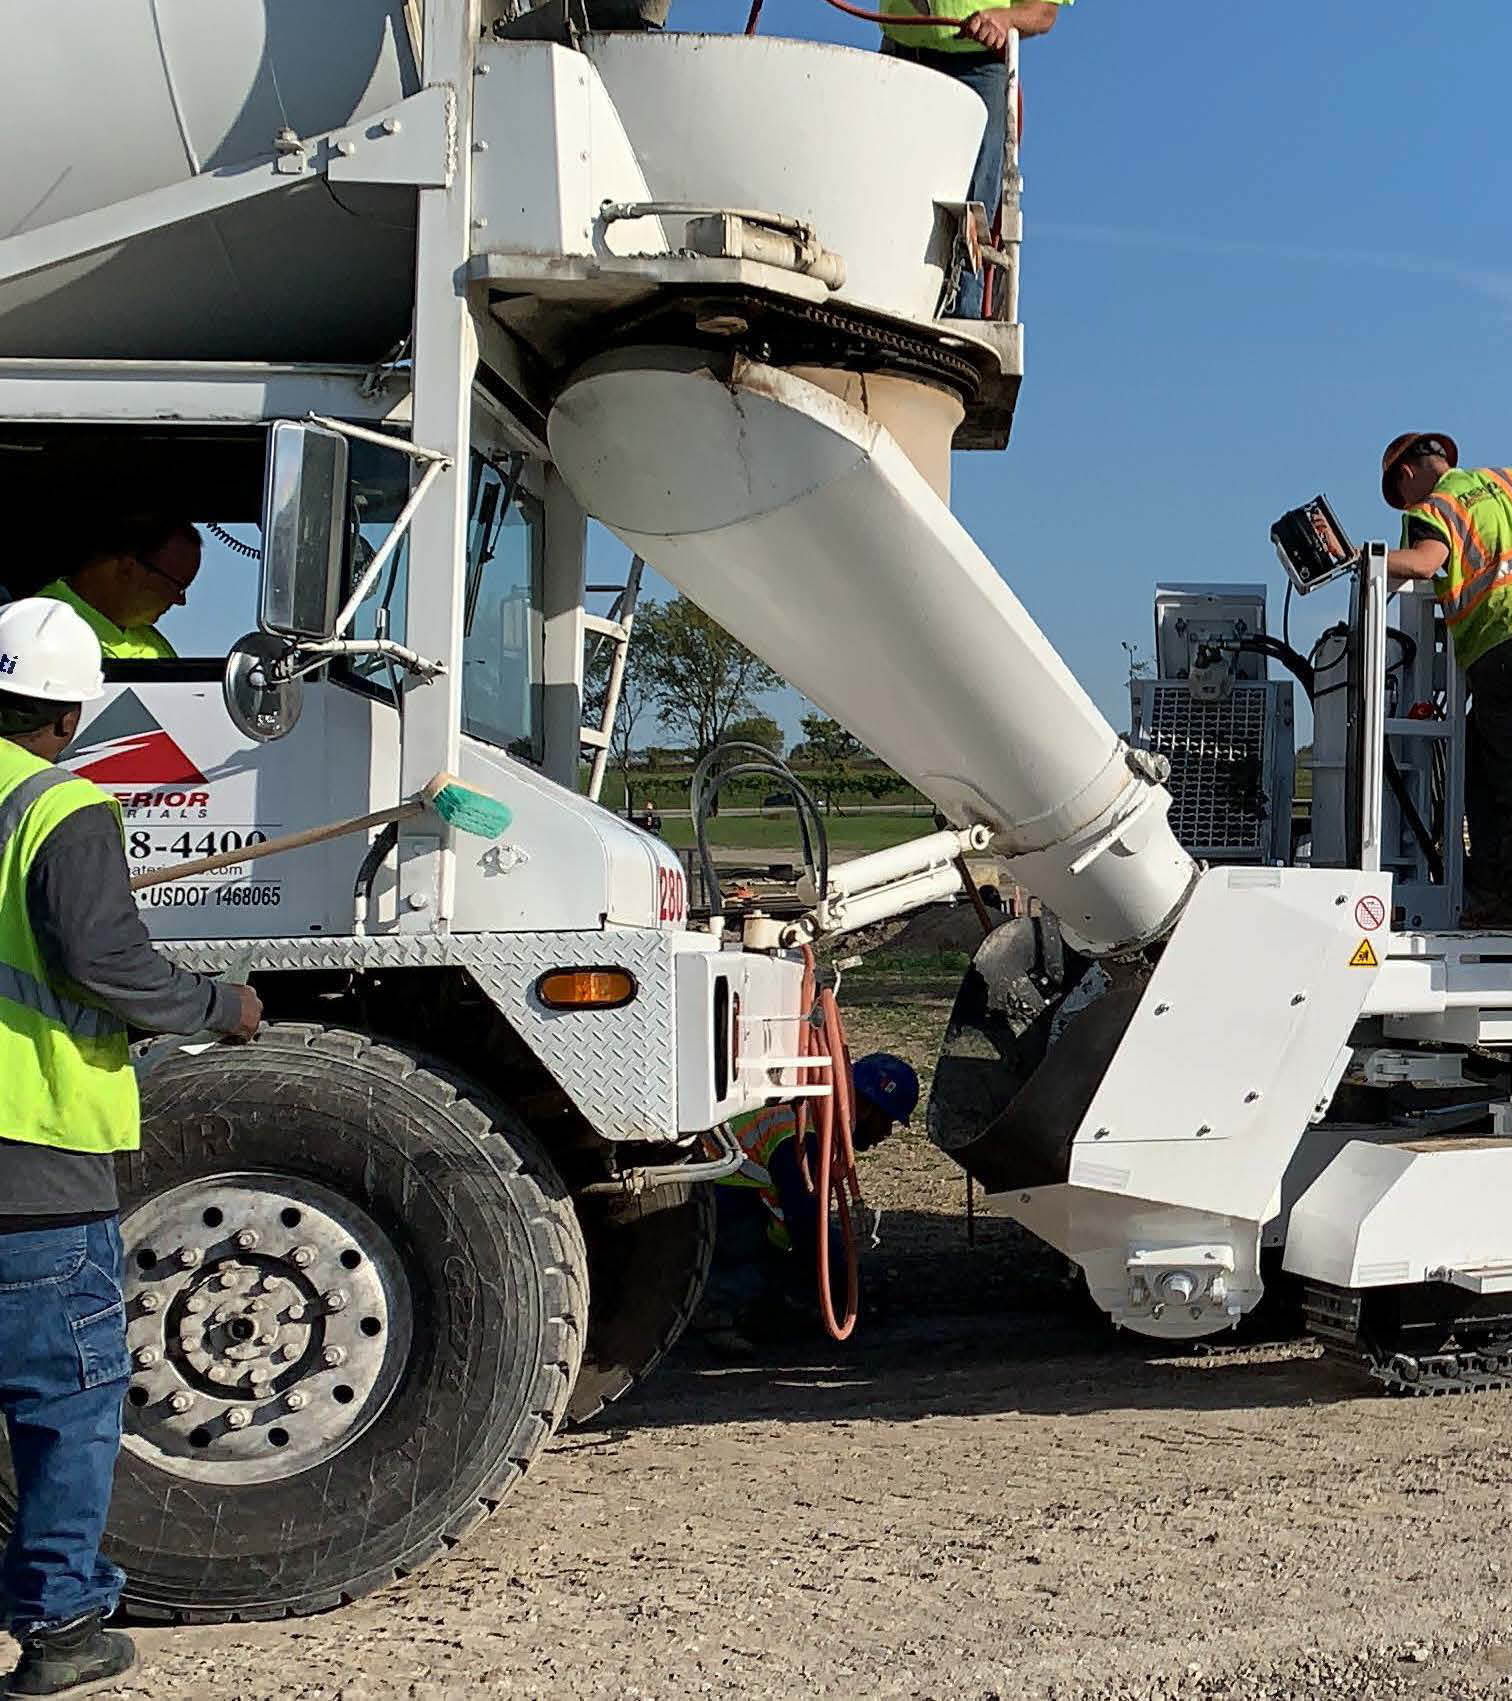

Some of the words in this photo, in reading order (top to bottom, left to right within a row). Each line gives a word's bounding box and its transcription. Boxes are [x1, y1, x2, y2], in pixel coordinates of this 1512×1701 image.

[150, 886, 209, 906] USDOT
[215, 886, 281, 906] 1468065
[658, 866, 684, 922] 280
